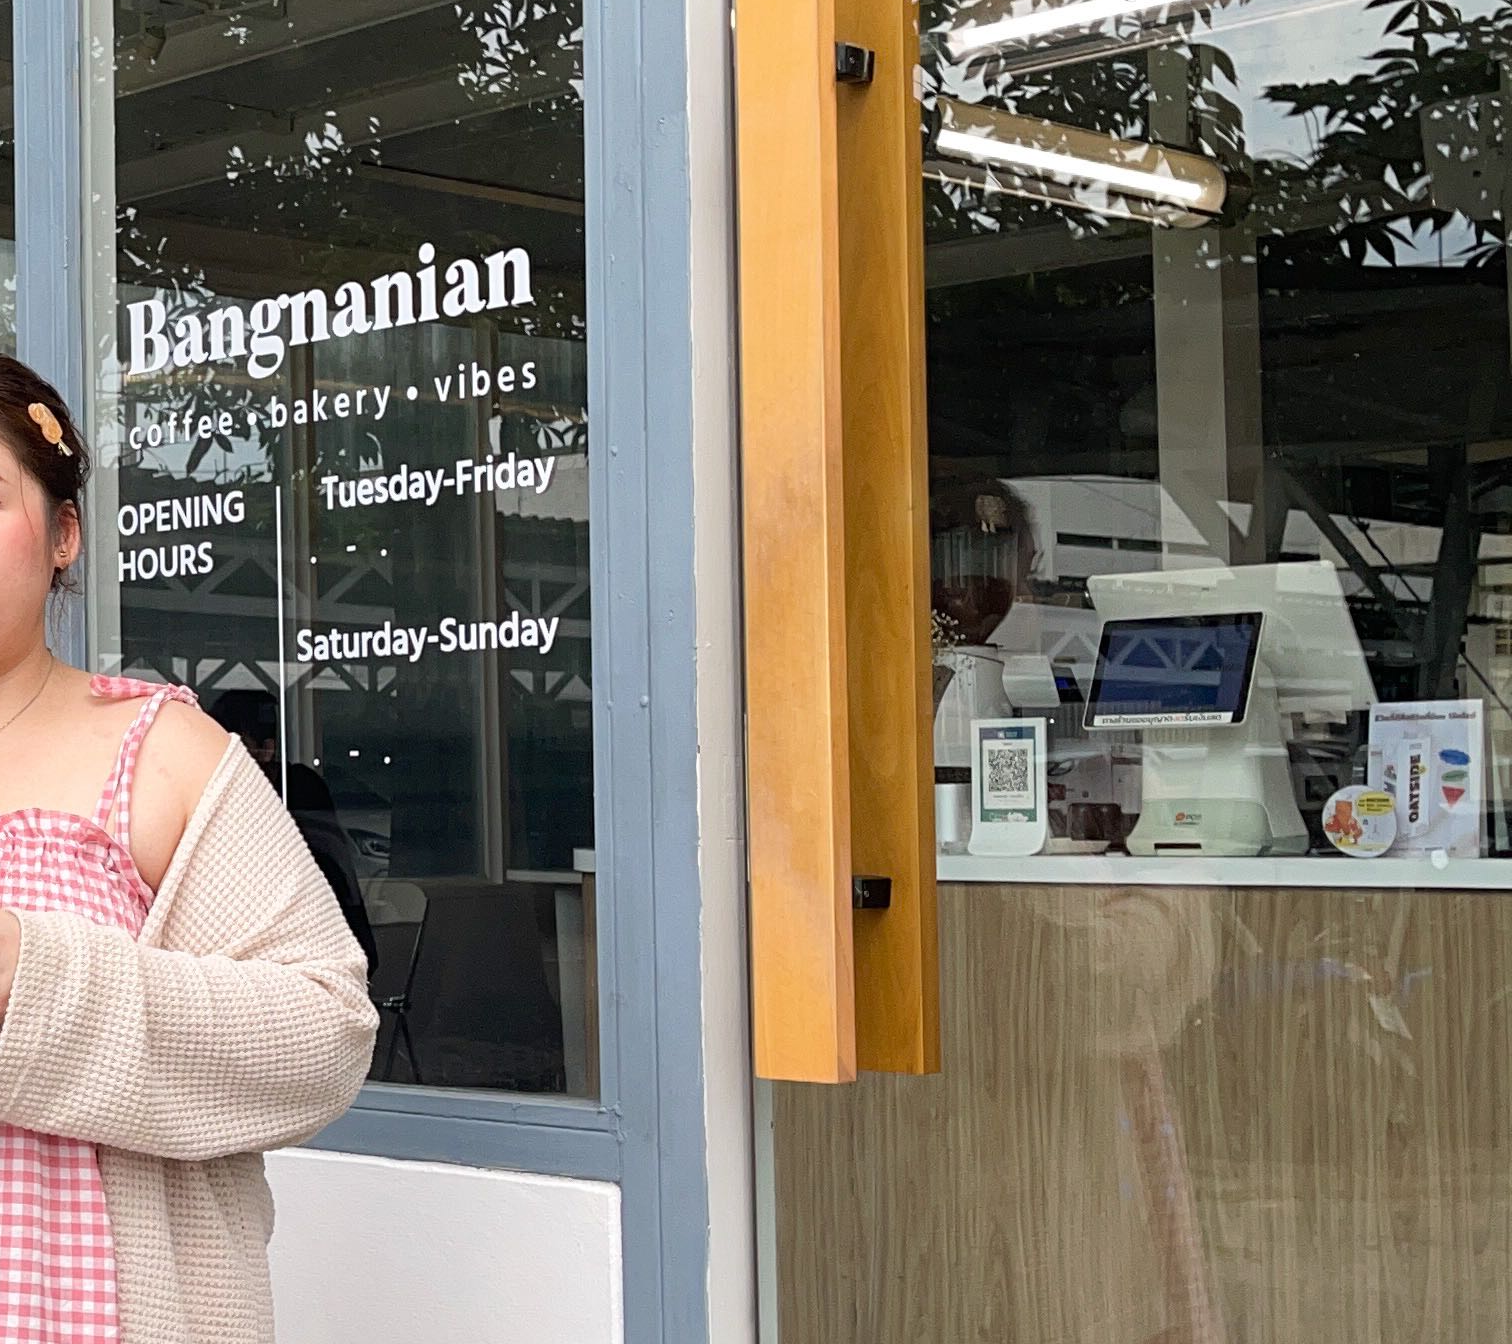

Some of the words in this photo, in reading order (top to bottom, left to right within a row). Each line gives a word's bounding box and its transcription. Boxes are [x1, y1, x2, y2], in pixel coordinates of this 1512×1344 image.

[126, 242, 534, 379] Bangnanian
[129, 410, 233, 450] coffee
[271, 385, 391, 429] bakery
[434, 361, 537, 402] vibes
[320, 451, 555, 511] Tuesday-Friday
[118, 490, 245, 536] OPENING
[118, 542, 214, 582] HOURS
[296, 611, 559, 662] Saturday-Sunday
[1409, 754, 1421, 823] OATSIDE
